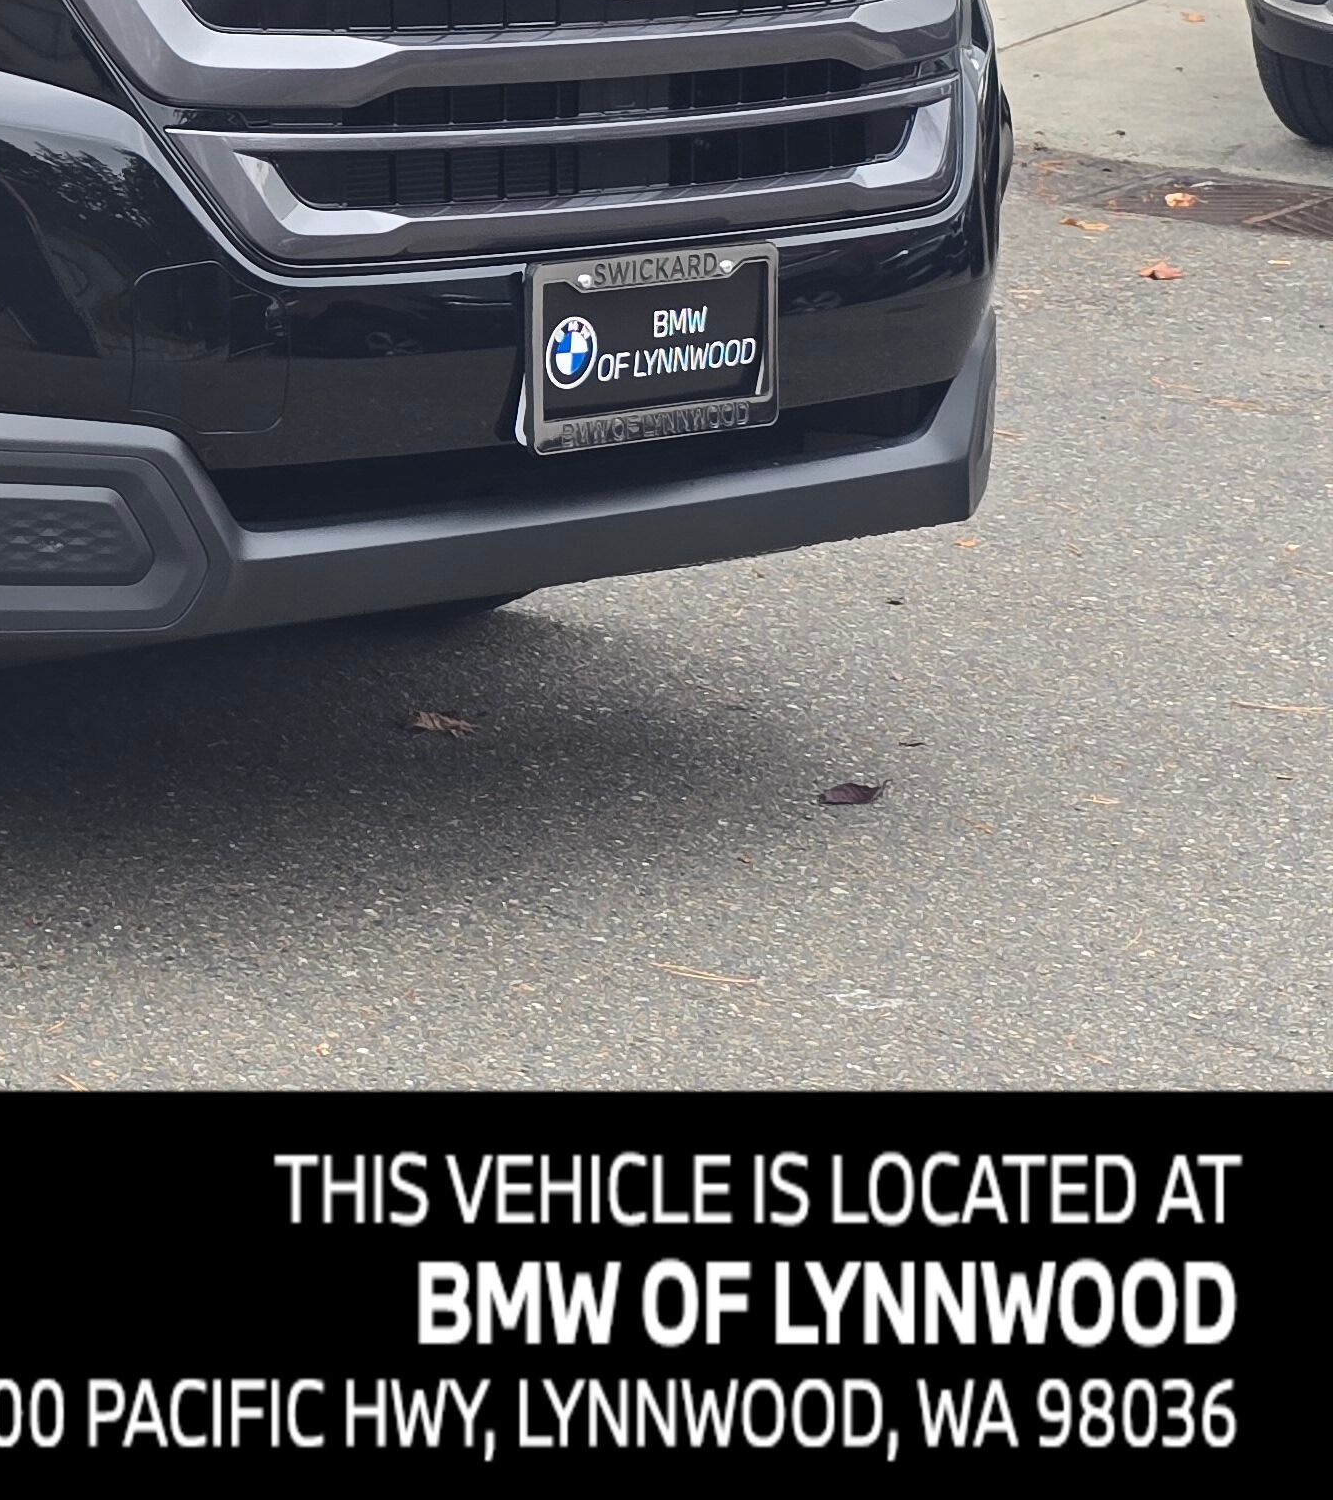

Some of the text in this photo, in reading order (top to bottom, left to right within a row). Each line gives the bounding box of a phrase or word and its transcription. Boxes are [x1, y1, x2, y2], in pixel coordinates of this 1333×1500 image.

[593, 252, 717, 286] SWICKARD
[653, 306, 708, 338] BMW
[597, 337, 757, 382] OF LYNNWOOD
